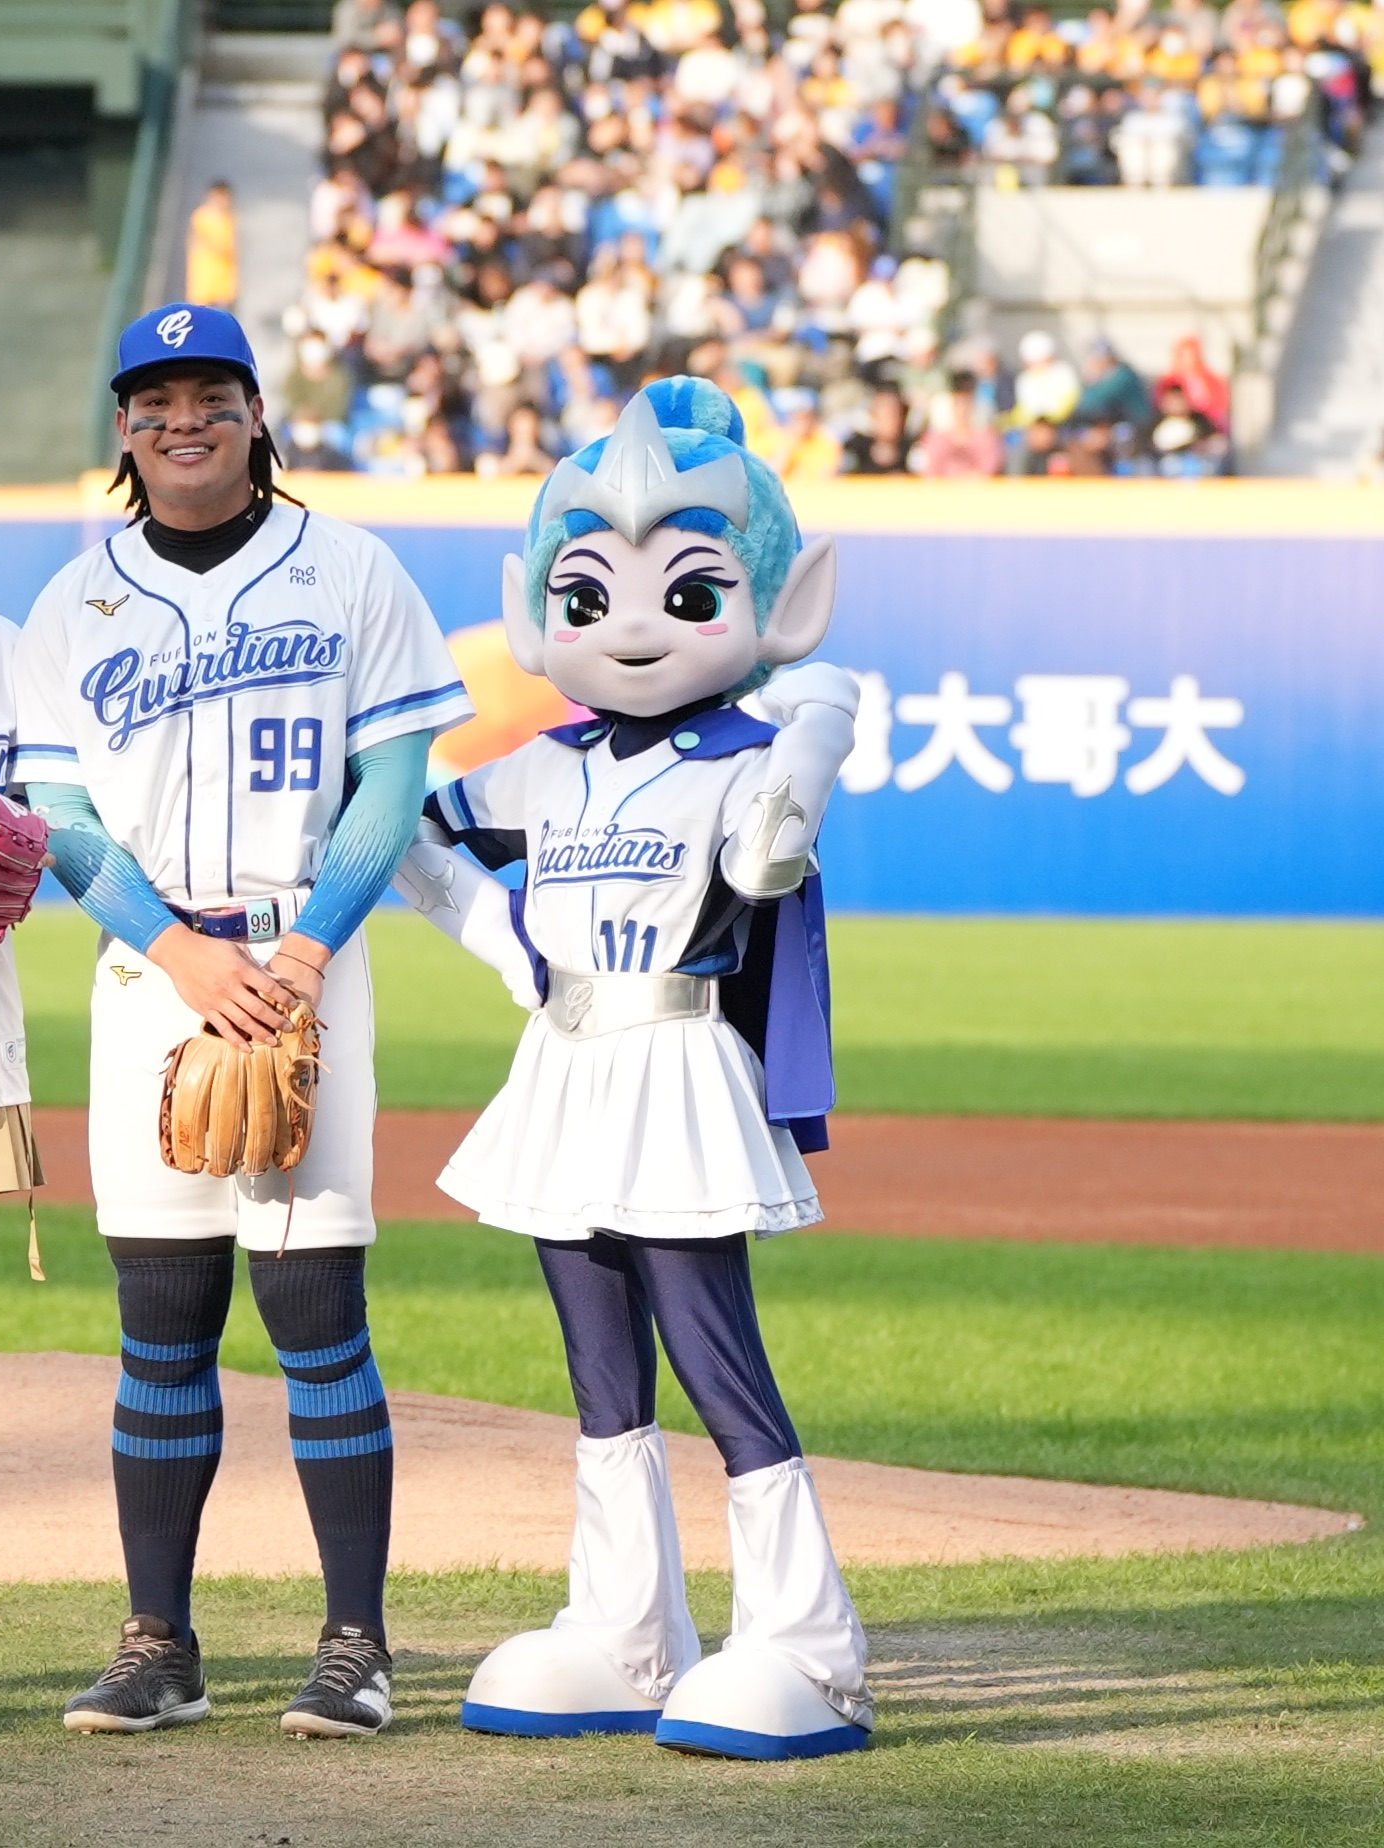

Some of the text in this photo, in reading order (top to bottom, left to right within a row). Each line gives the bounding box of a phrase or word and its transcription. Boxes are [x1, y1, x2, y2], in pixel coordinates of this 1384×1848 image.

[80, 620, 345, 752] Guardians
[249, 717, 323, 793] 99
[534, 820, 687, 890] uardians
[250, 912, 271, 934] 99
[599, 919, 659, 974] 111
